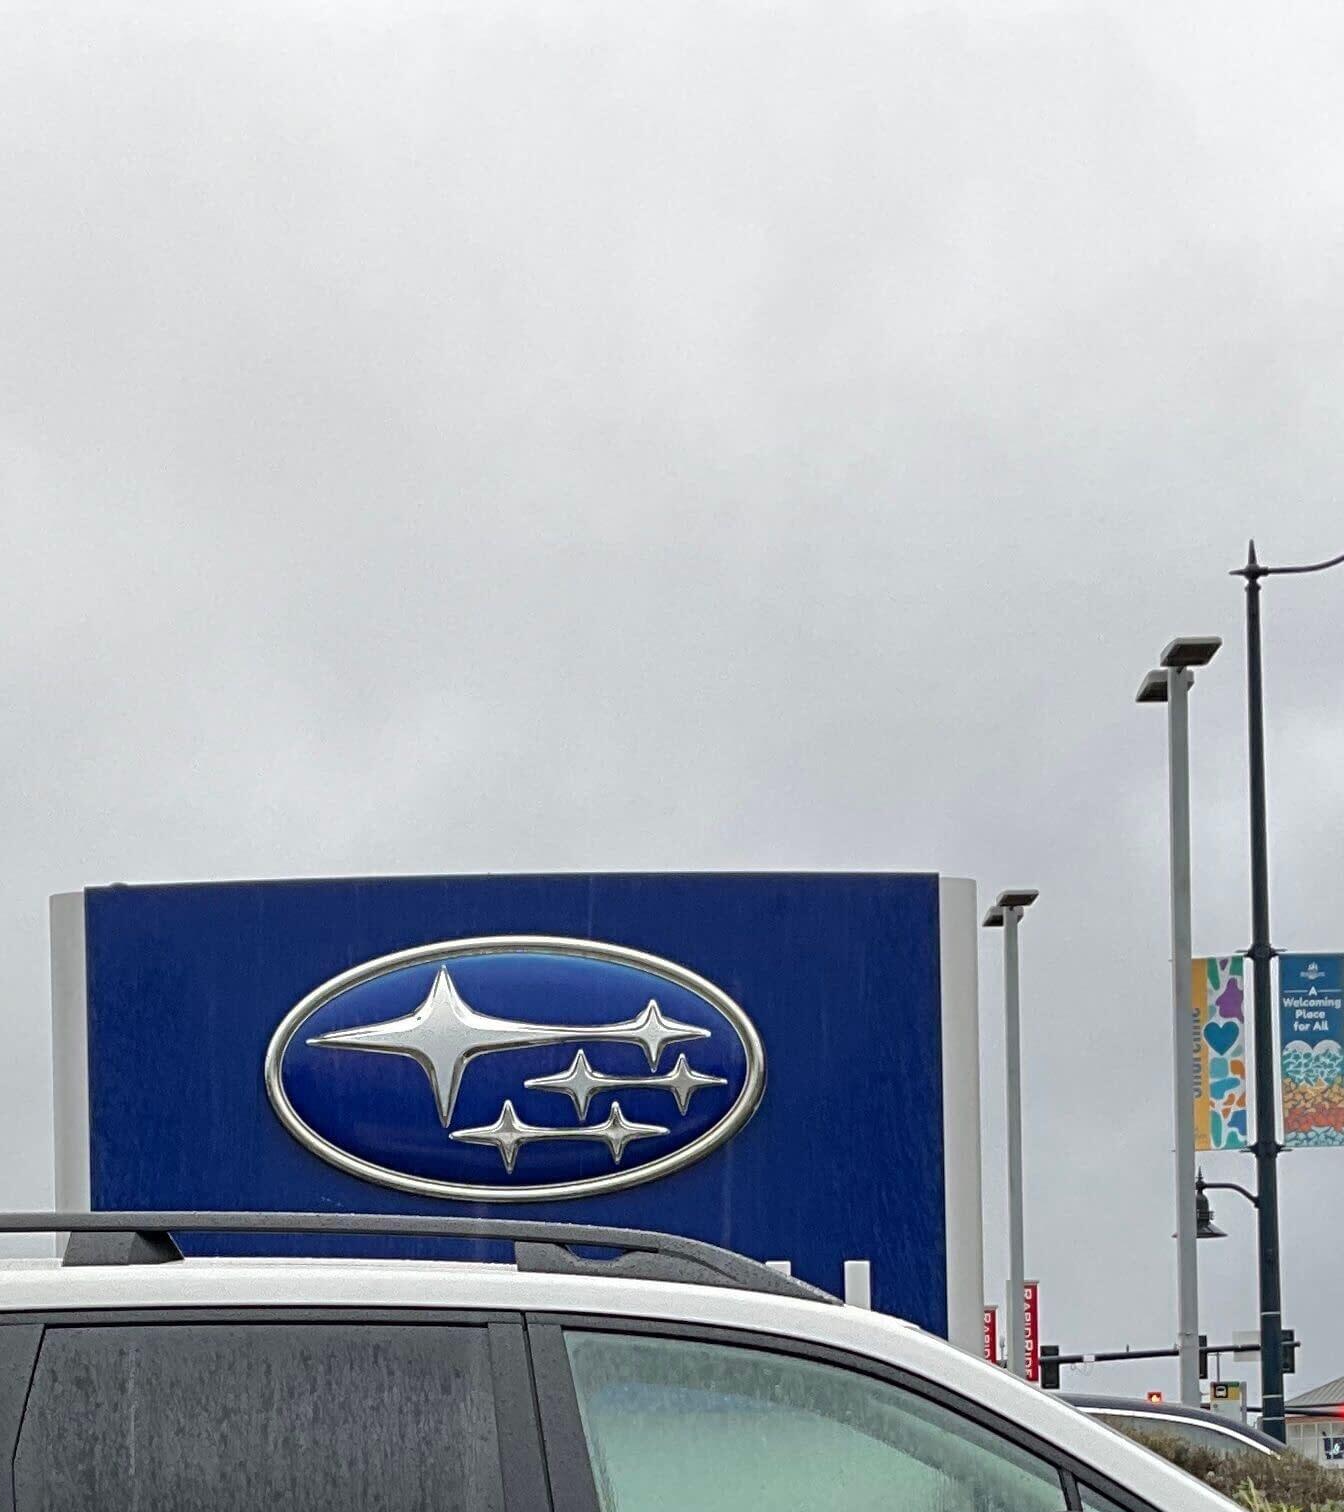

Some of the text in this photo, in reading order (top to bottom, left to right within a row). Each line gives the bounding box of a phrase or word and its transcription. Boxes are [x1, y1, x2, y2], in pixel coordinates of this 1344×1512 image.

[1308, 986, 1318, 996] A
[1283, 996, 1342, 1009] Welcoming
[1295, 1009, 1326, 1019] Place
[1293, 1020, 1329, 1031] for All
